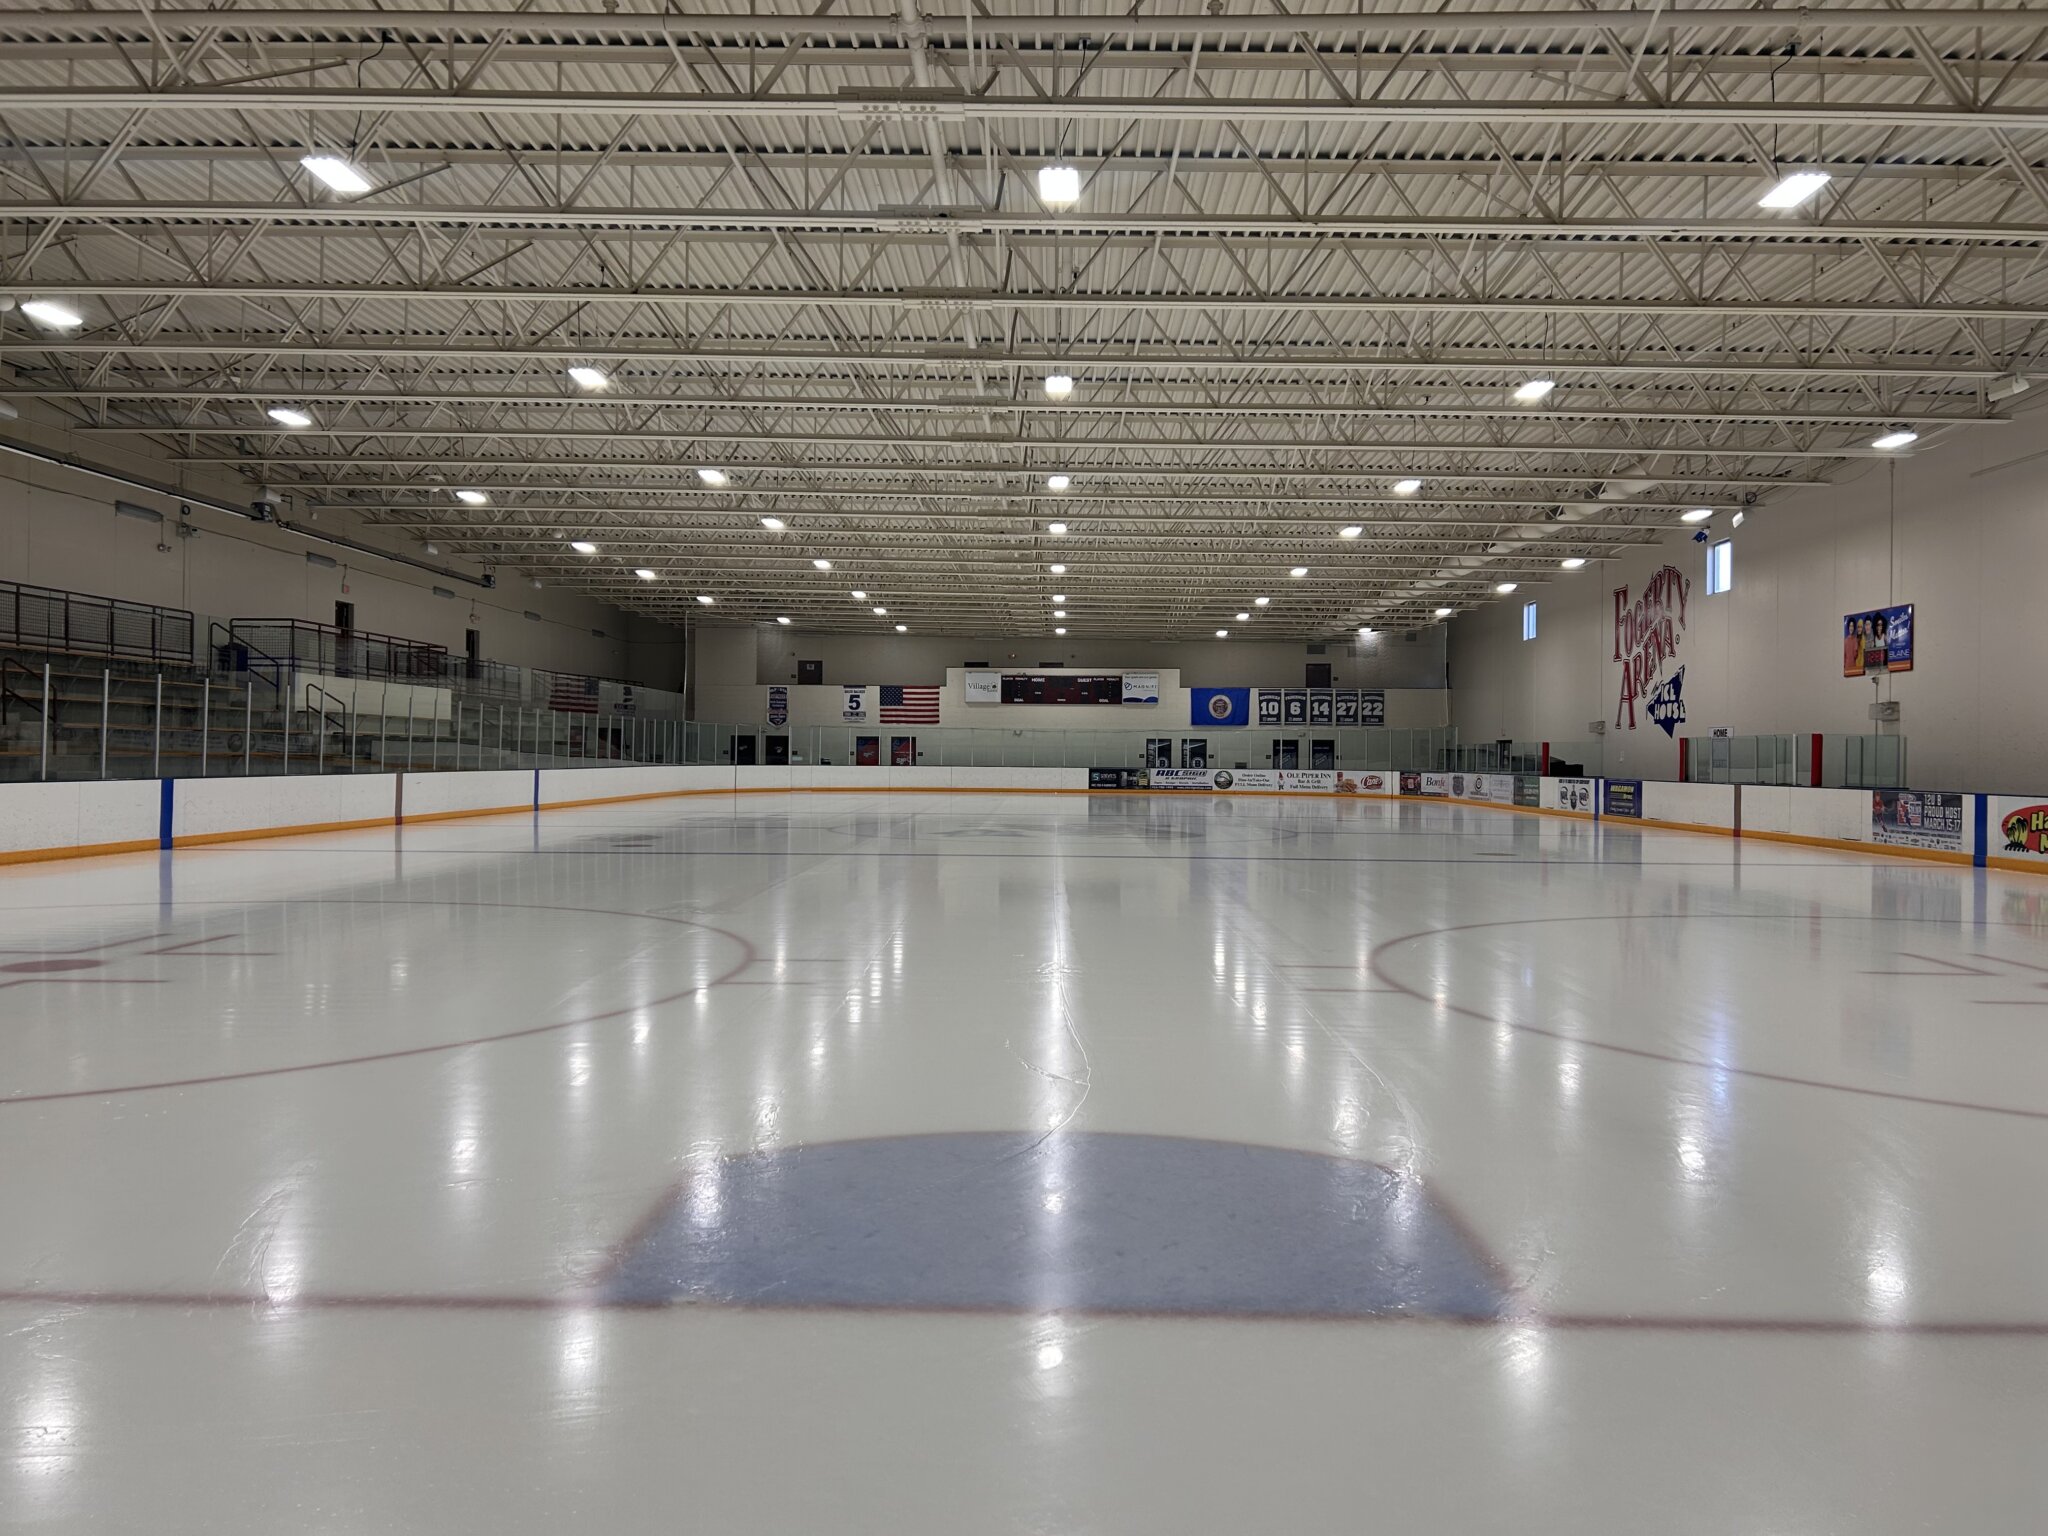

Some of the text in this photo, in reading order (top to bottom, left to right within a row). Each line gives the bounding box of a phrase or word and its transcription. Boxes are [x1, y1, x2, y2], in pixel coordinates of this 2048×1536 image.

[1613, 564, 1691, 663] FOGERTY
[1888, 648, 1910, 658] BLAINE
[967, 682, 992, 692] Village
[1660, 683, 1677, 702] ICE
[848, 694, 861, 711] 5
[1260, 701, 1279, 715] 10
[1290, 701, 1301, 715] 6
[1312, 702, 1329, 715] 14
[1336, 702, 1358, 716] 27
[1362, 702, 1383, 716] 22
[1654, 700, 1686, 720] HOUSE
[1713, 728, 1728, 738] HOME
[1155, 769, 1183, 777] ABC
[1924, 794, 1935, 805] 12U
[1937, 795, 1942, 805] B
[1924, 805, 1944, 818] PROUD
[1945, 807, 1961, 819] HOST
[1924, 817, 1961, 832] MARCH 15-17
